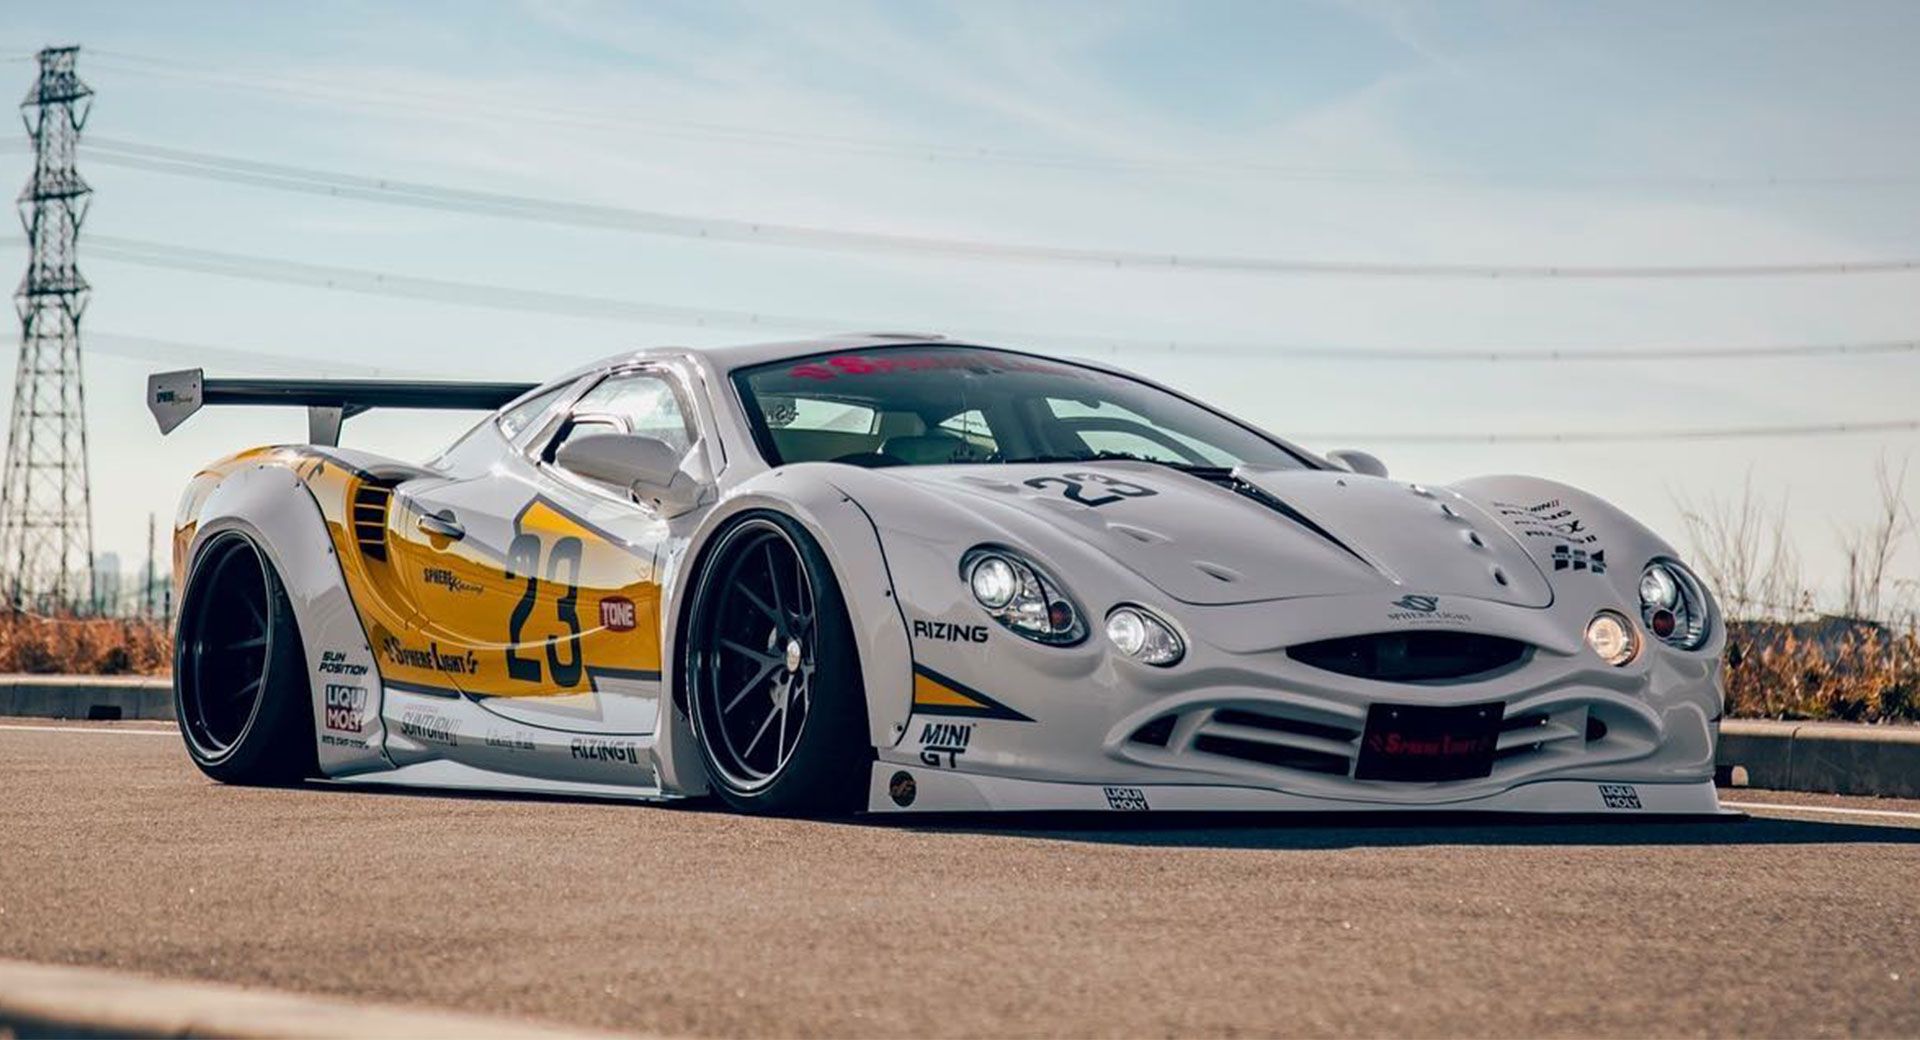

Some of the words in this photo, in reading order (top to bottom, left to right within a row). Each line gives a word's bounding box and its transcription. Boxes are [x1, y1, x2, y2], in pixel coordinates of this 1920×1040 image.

[1023, 473, 1159, 507] 23
[505, 533, 583, 688] 23
[602, 601, 635, 627] TONE
[914, 620, 989, 643] RIZING
[322, 651, 346, 662] SUN
[318, 662, 368, 675] POSITION
[327, 686, 366, 710] LIQUI
[327, 708, 362, 730] MOLY
[919, 723, 971, 746] MINI
[920, 746, 966, 769] GT
[1105, 788, 1143, 799] LIQUI
[1600, 785, 1636, 797] LIQUI
[1110, 799, 1147, 810] MOLY
[1605, 797, 1641, 808] MOLY
